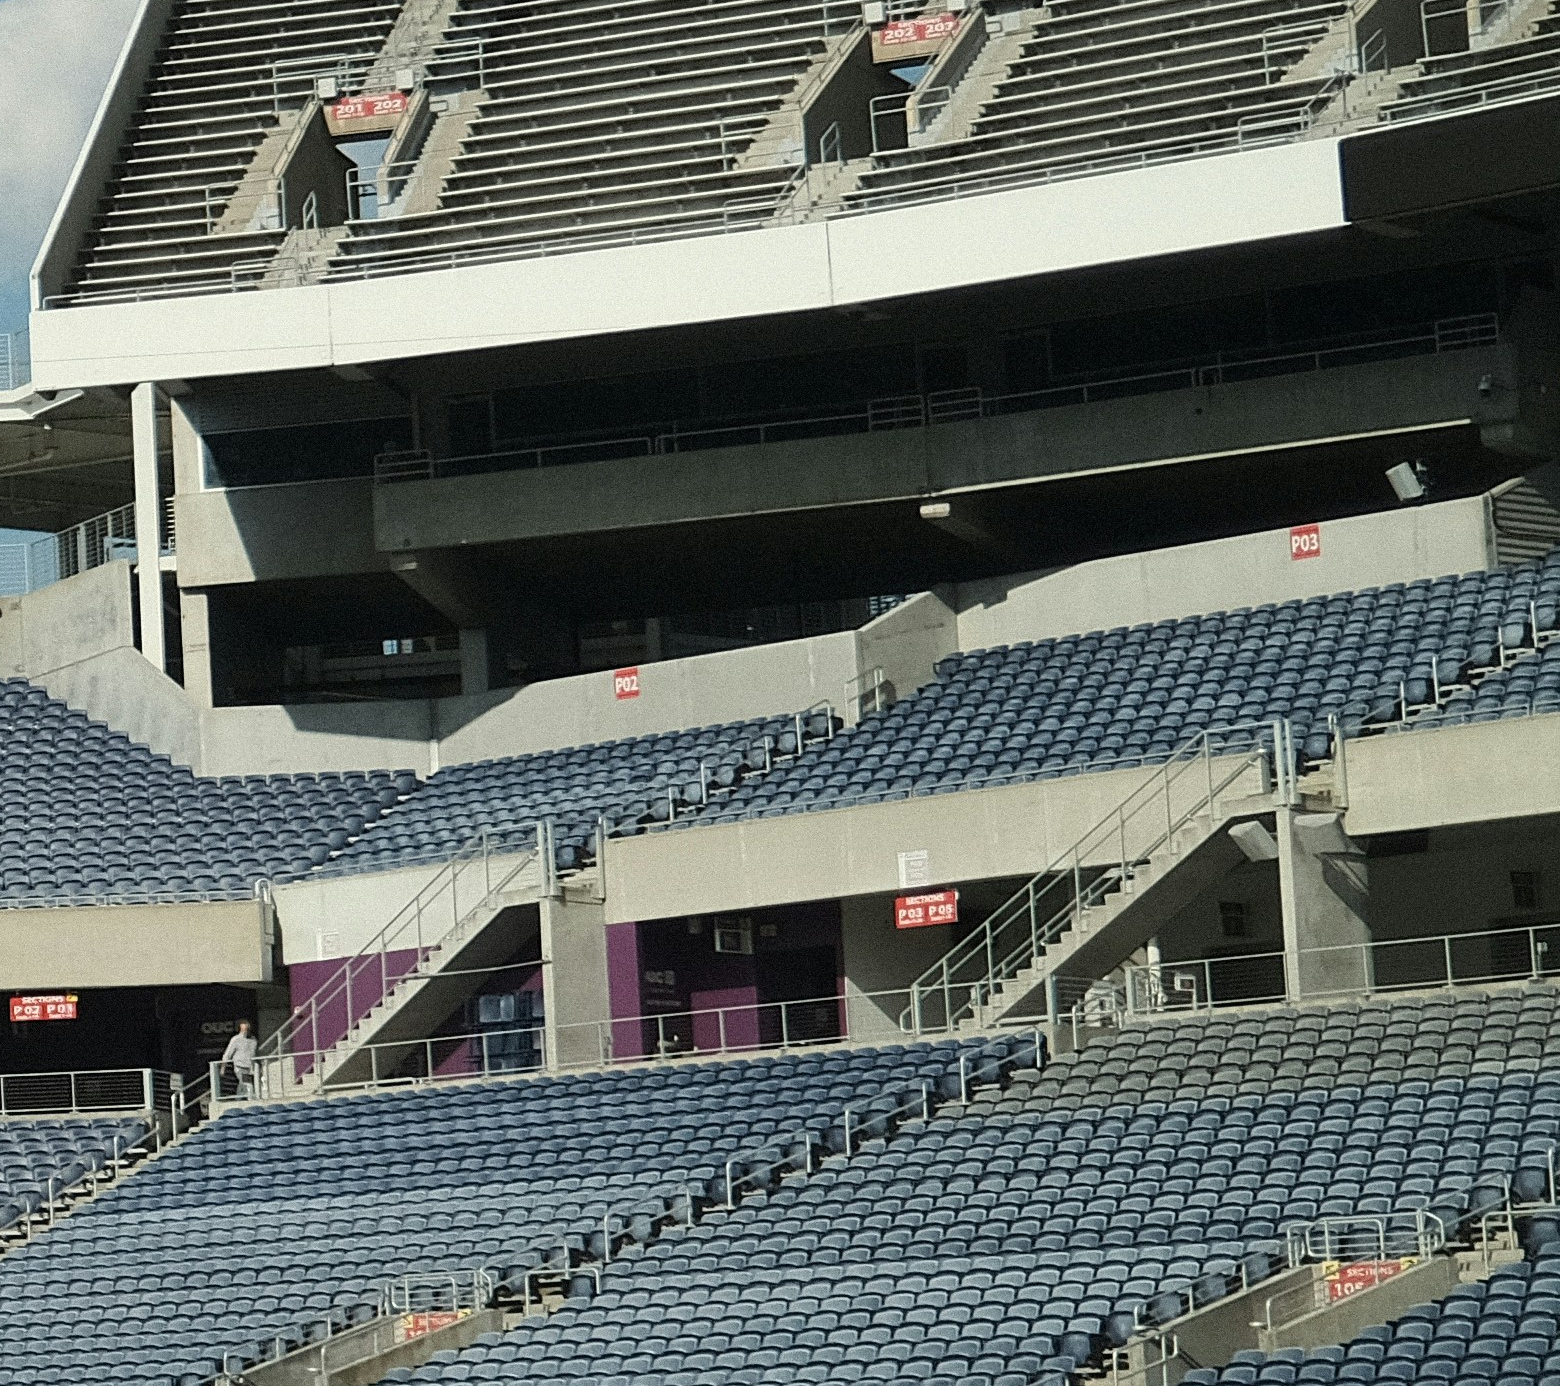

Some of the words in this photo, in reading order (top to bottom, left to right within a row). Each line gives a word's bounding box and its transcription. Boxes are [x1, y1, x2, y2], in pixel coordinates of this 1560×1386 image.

[884, 27, 914, 40] 202
[336, 103, 364, 115] 201
[373, 99, 403, 111] 202
[1291, 533, 1319, 554] P03
[615, 675, 639, 694] P02
